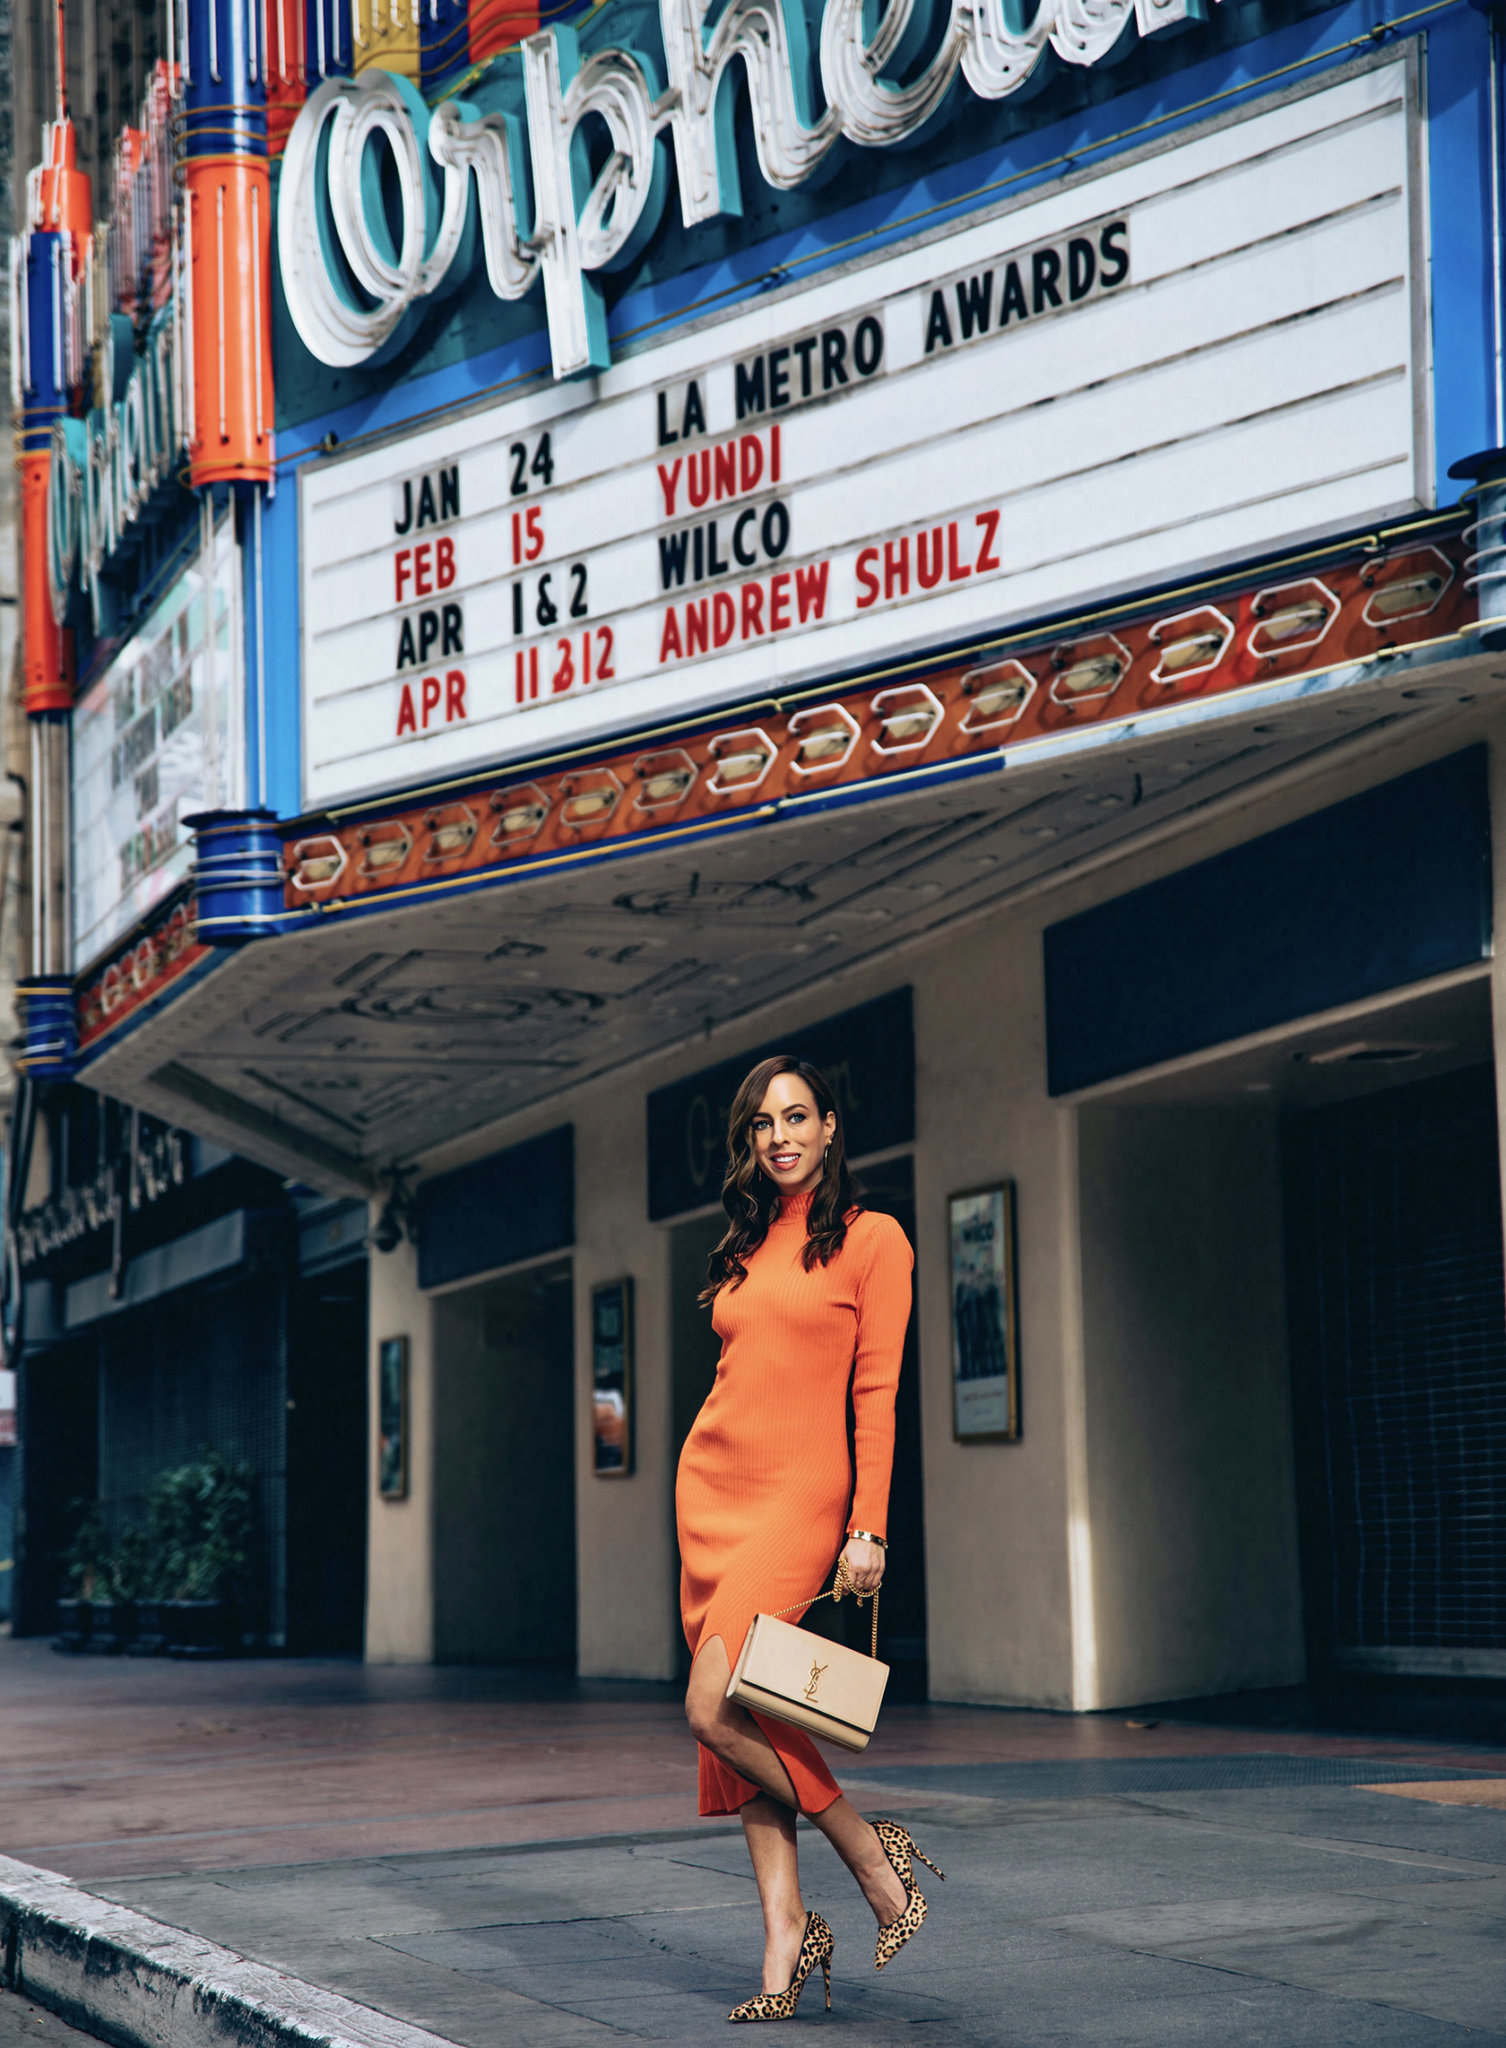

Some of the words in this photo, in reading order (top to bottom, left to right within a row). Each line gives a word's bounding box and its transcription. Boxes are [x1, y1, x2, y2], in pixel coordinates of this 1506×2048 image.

[394, 465, 460, 535] JAN
[510, 431, 555, 496] 24
[657, 380, 707, 447] LA
[735, 316, 885, 421] METRO
[924, 220, 1130, 354] AWARDS
[394, 536, 457, 603] FEB
[511, 505, 545, 565] 15
[657, 425, 781, 517] YUNDI
[396, 603, 464, 670] APR
[658, 500, 790, 590] WILCO
[396, 669, 467, 736] APR
[659, 560, 830, 663] ANDREW
[856, 508, 1001, 609] SHULZ
